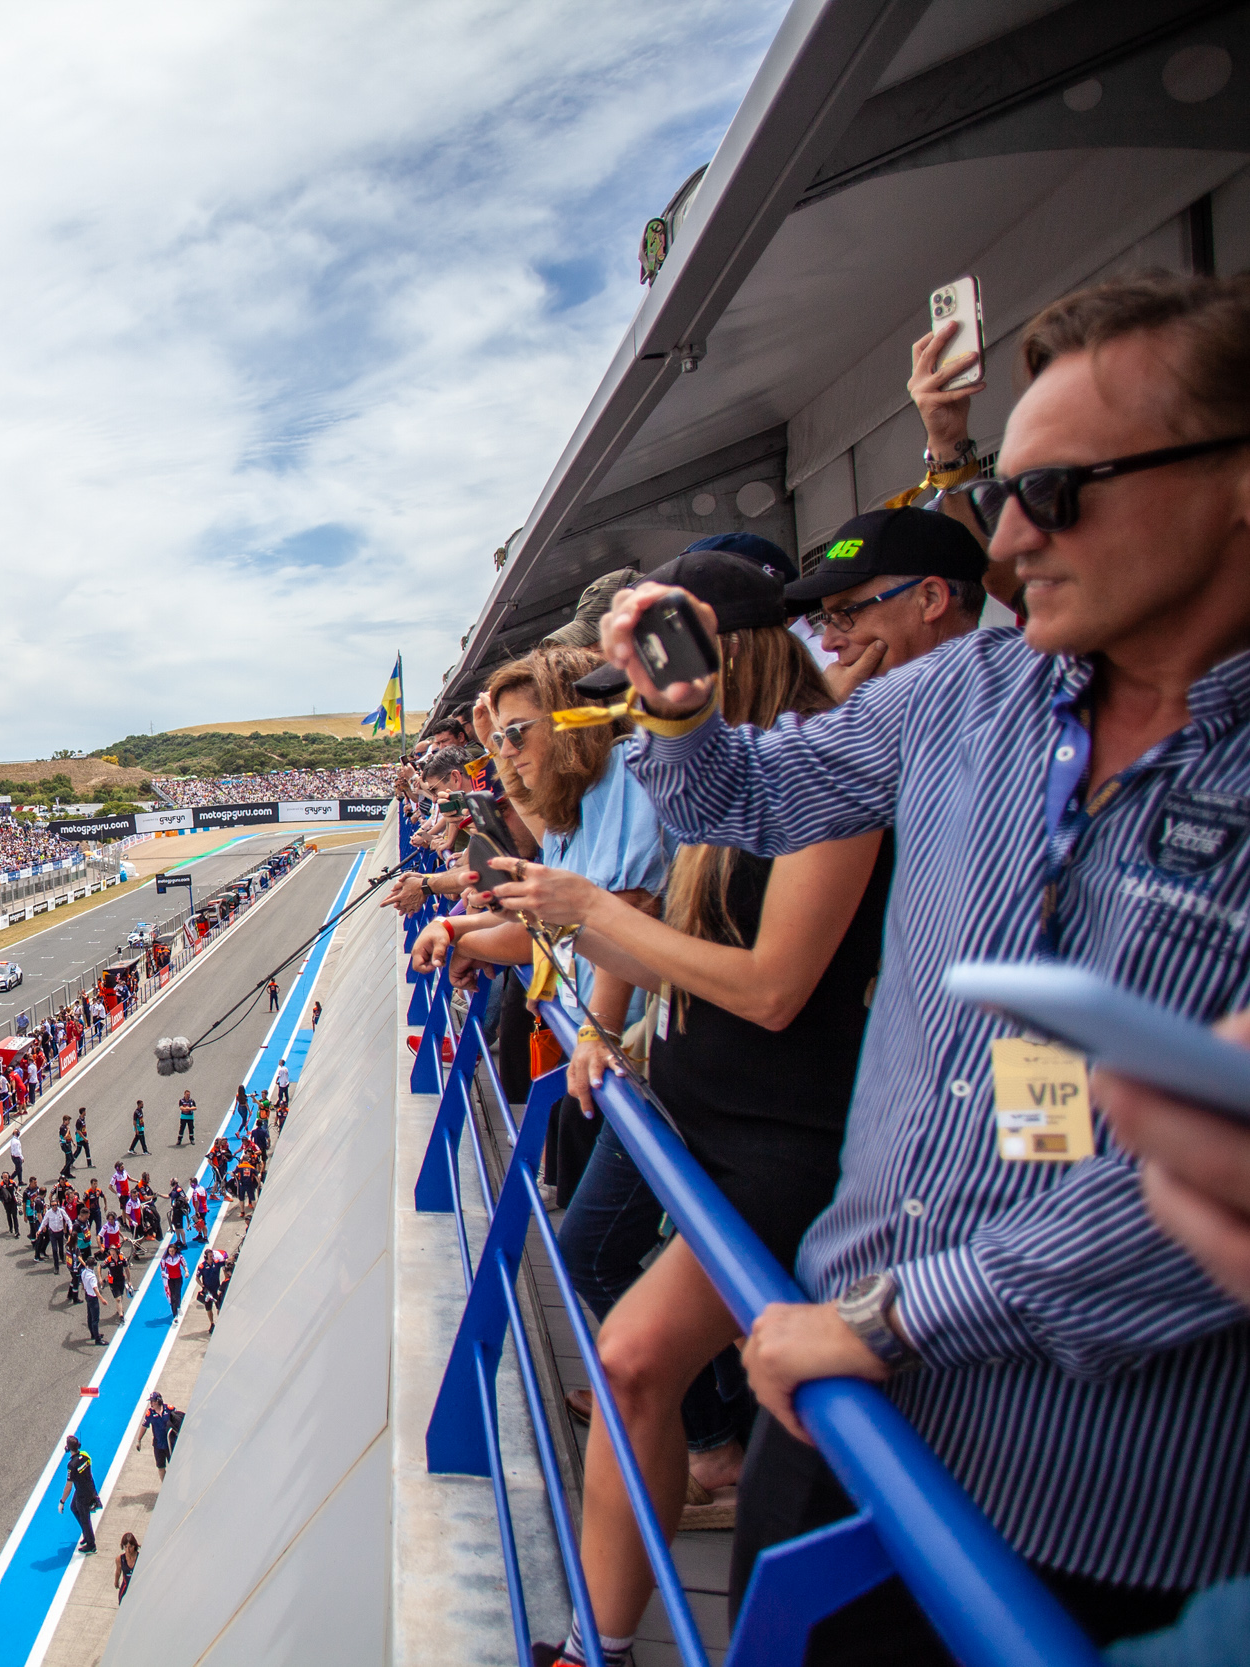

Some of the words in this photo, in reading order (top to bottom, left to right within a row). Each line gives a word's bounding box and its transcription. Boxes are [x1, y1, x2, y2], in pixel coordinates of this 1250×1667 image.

[826, 538, 864, 559] 46
[199, 807, 272, 821] motogpguru.com
[60, 820, 129, 835] motogpguru.com
[111, 1010, 123, 1026] Lenovo
[60, 1050, 76, 1071] Lenovo
[1027, 1083, 1079, 1106] VIP
